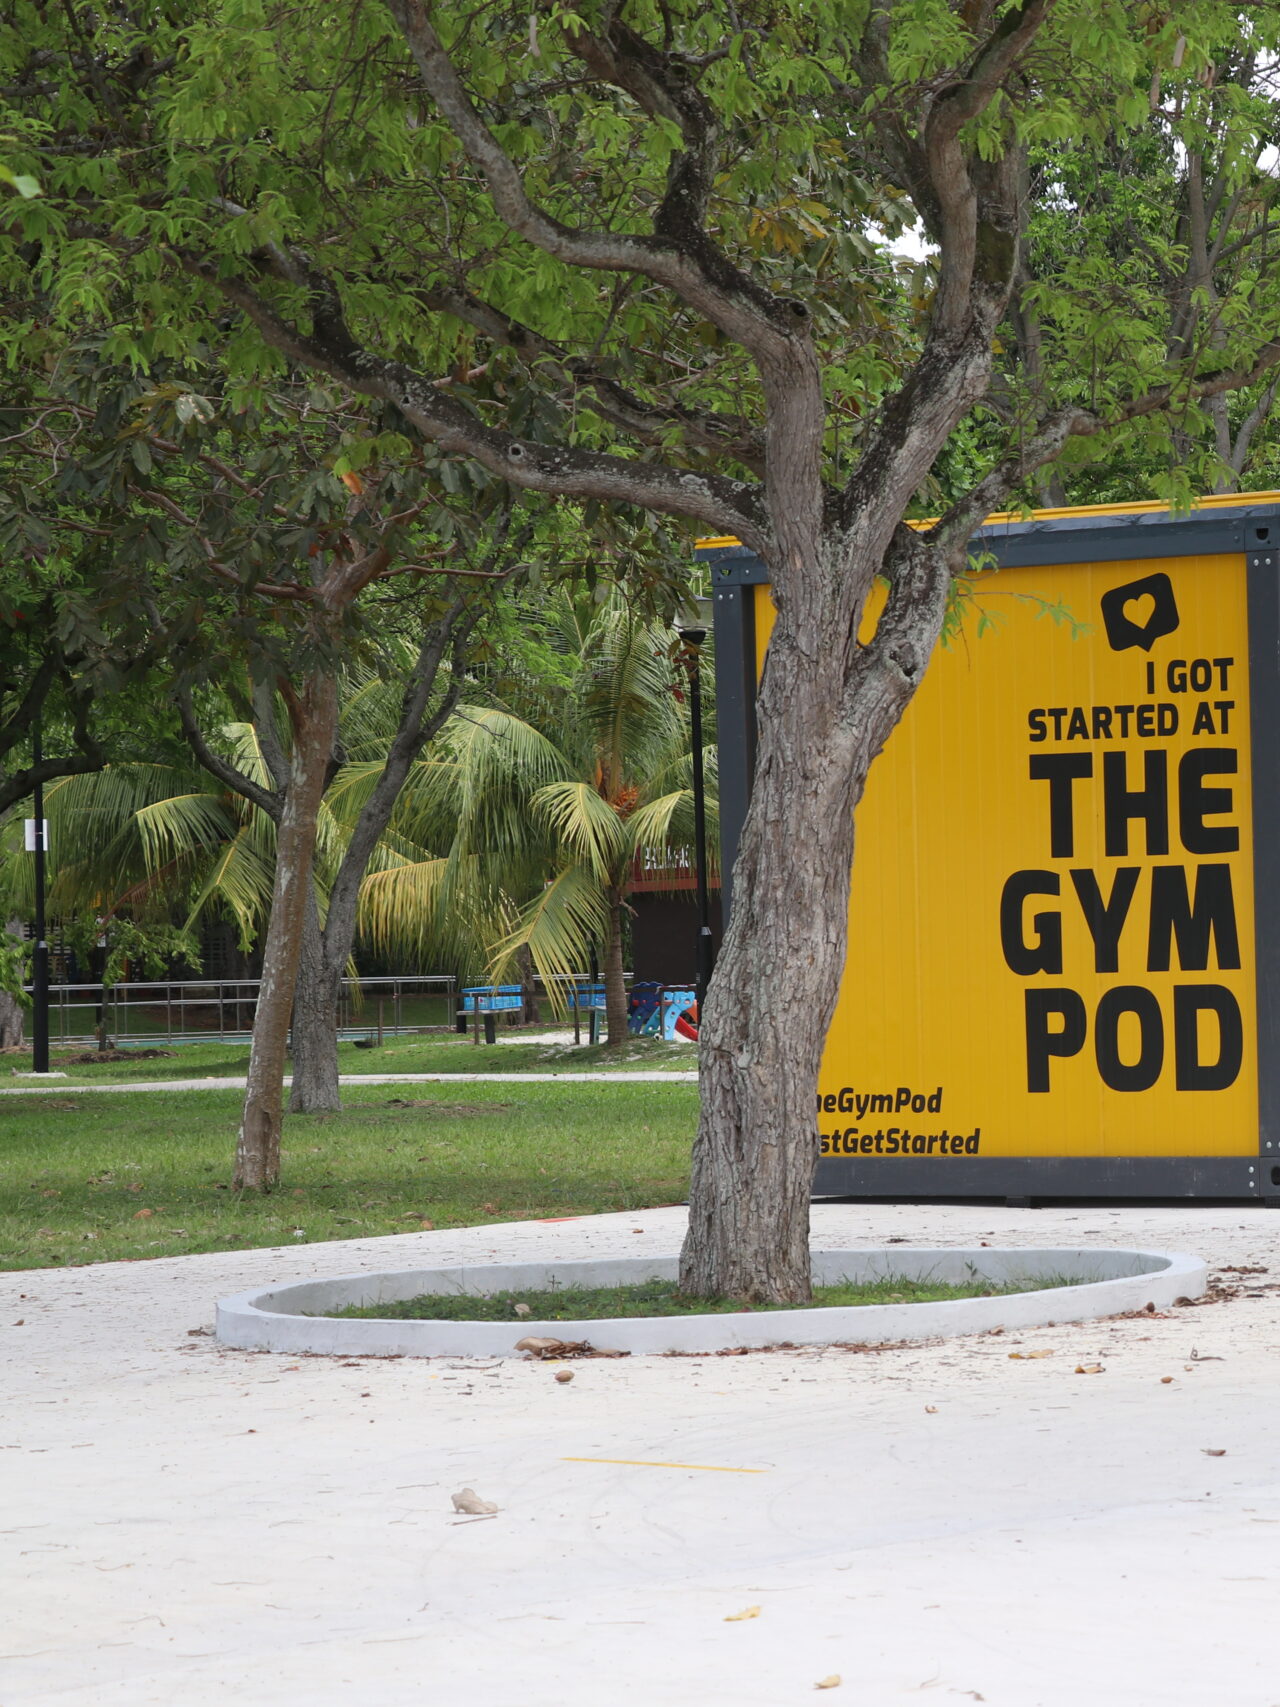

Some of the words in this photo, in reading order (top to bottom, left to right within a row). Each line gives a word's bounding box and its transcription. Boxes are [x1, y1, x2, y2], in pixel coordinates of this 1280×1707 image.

[1146, 661, 1155, 694] I
[1167, 657, 1234, 693] GOT
[1028, 703, 1179, 742] STARTED
[1192, 700, 1235, 735] AT
[1029, 747, 1240, 858] THE
[1000, 863, 1241, 976] GYM
[1024, 983, 1243, 1093] POD
[817, 1087, 943, 1121] eGymPod
[821, 1128, 981, 1154] stGetStarted
